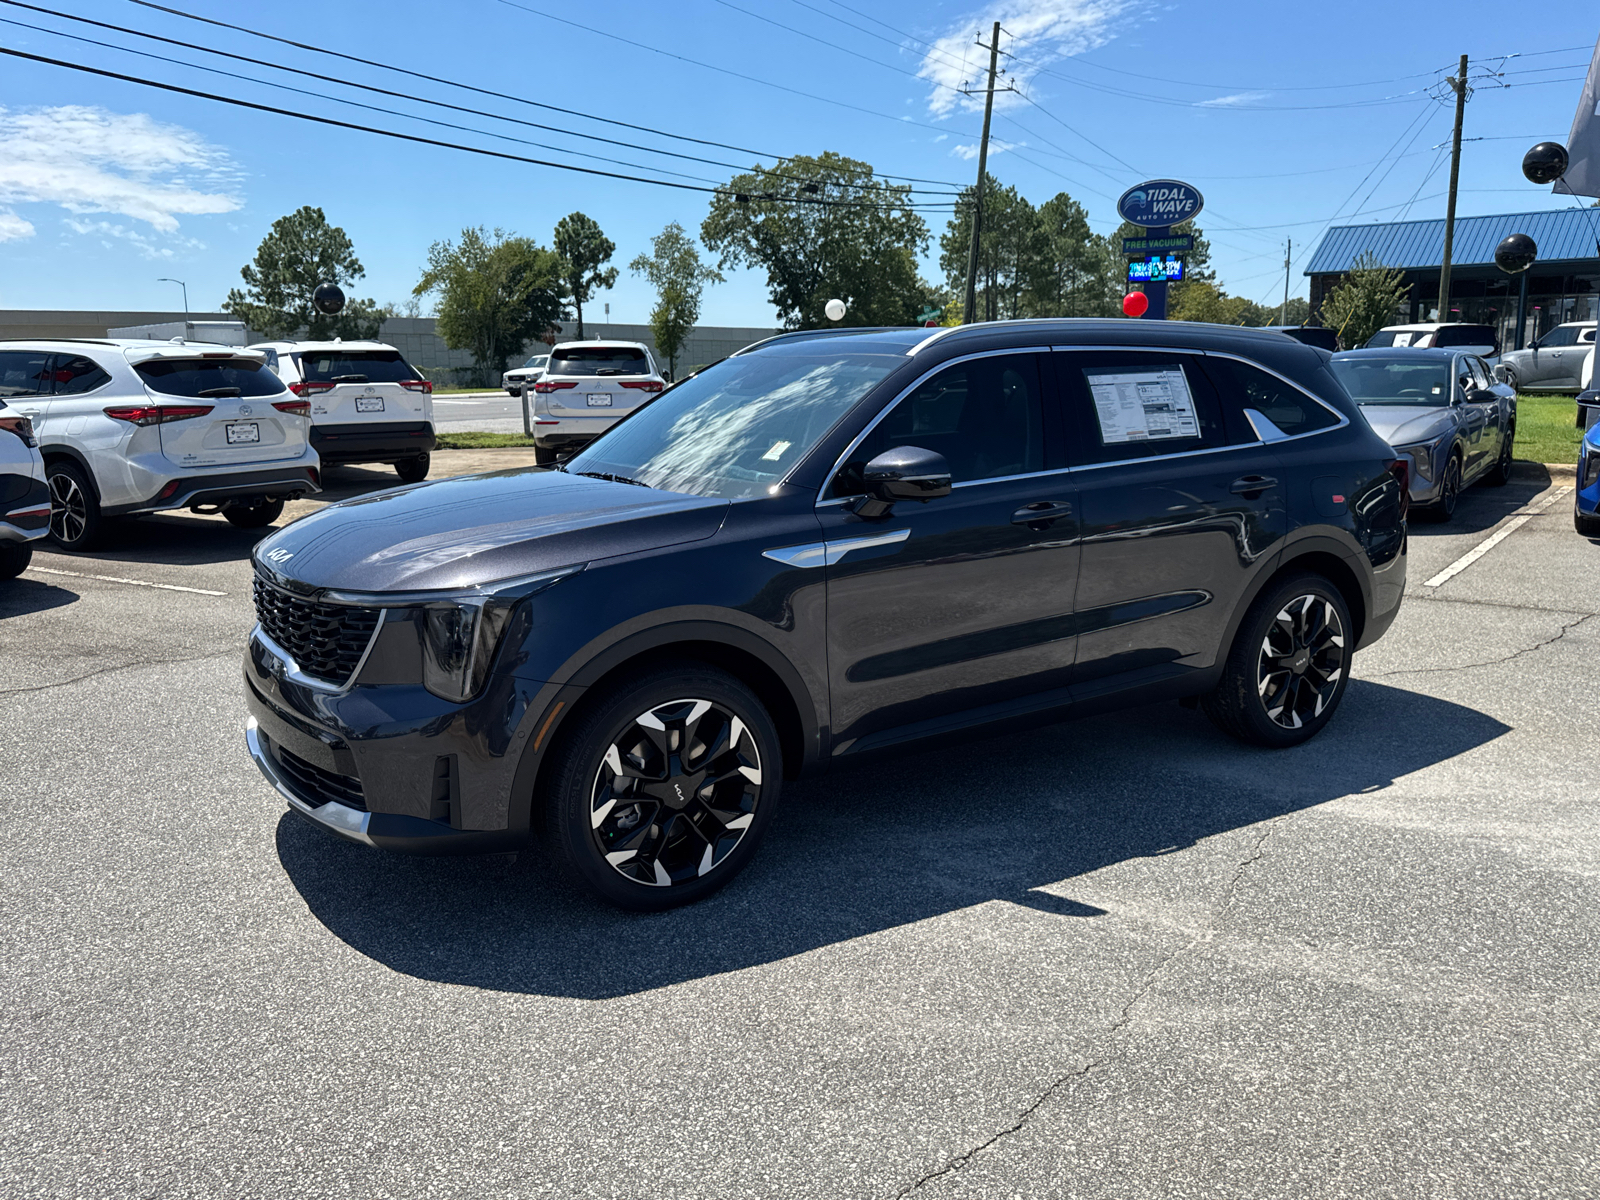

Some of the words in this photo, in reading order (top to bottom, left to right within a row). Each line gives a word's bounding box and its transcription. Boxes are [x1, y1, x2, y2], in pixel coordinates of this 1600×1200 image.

[1147, 187, 1186, 201] TIDAL
[1153, 199, 1193, 213] WAVE
[1125, 240, 1147, 249] FREE
[1148, 237, 1188, 248] VACUUMS
